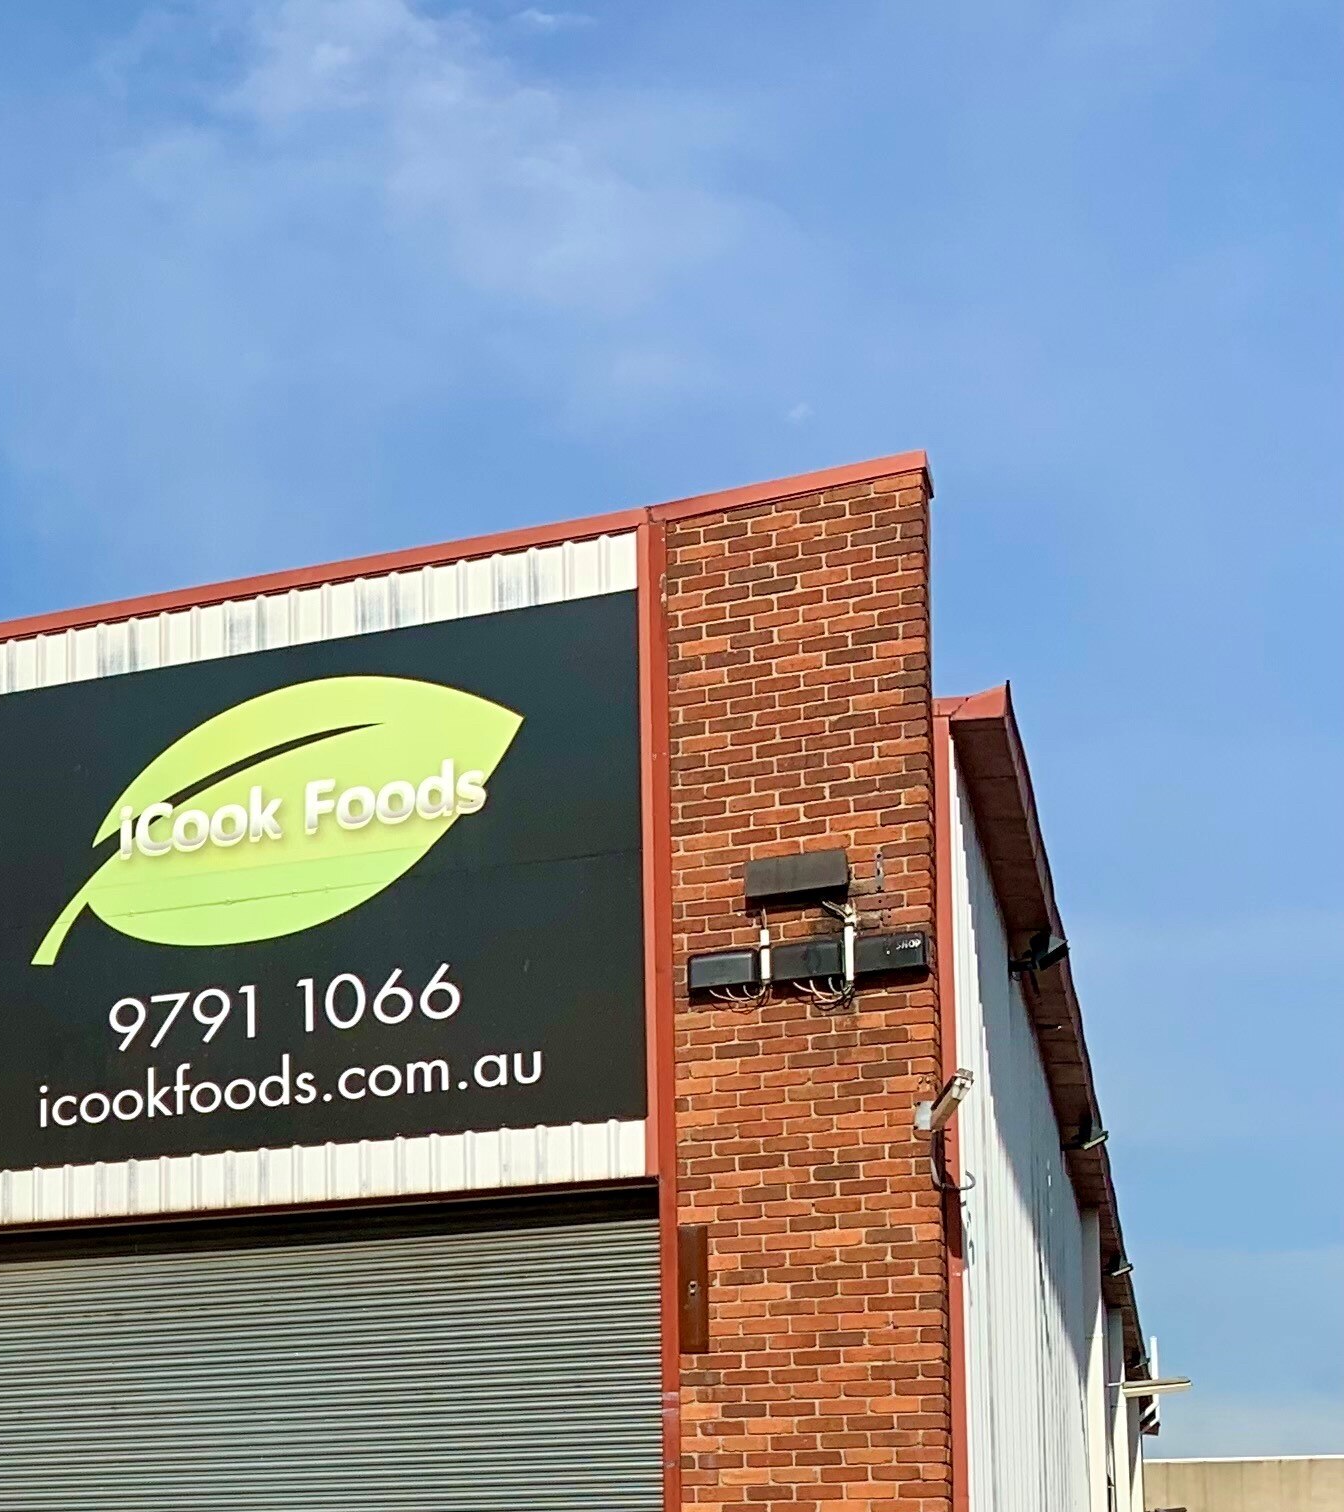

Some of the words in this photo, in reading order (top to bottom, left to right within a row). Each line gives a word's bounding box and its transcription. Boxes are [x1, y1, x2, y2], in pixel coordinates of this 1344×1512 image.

[118, 784, 284, 861] iCook
[303, 757, 488, 836] Foods
[108, 985, 257, 1053] 9791
[296, 962, 463, 1033] 1066
[38, 1050, 543, 1128] icookfoods.com.au
